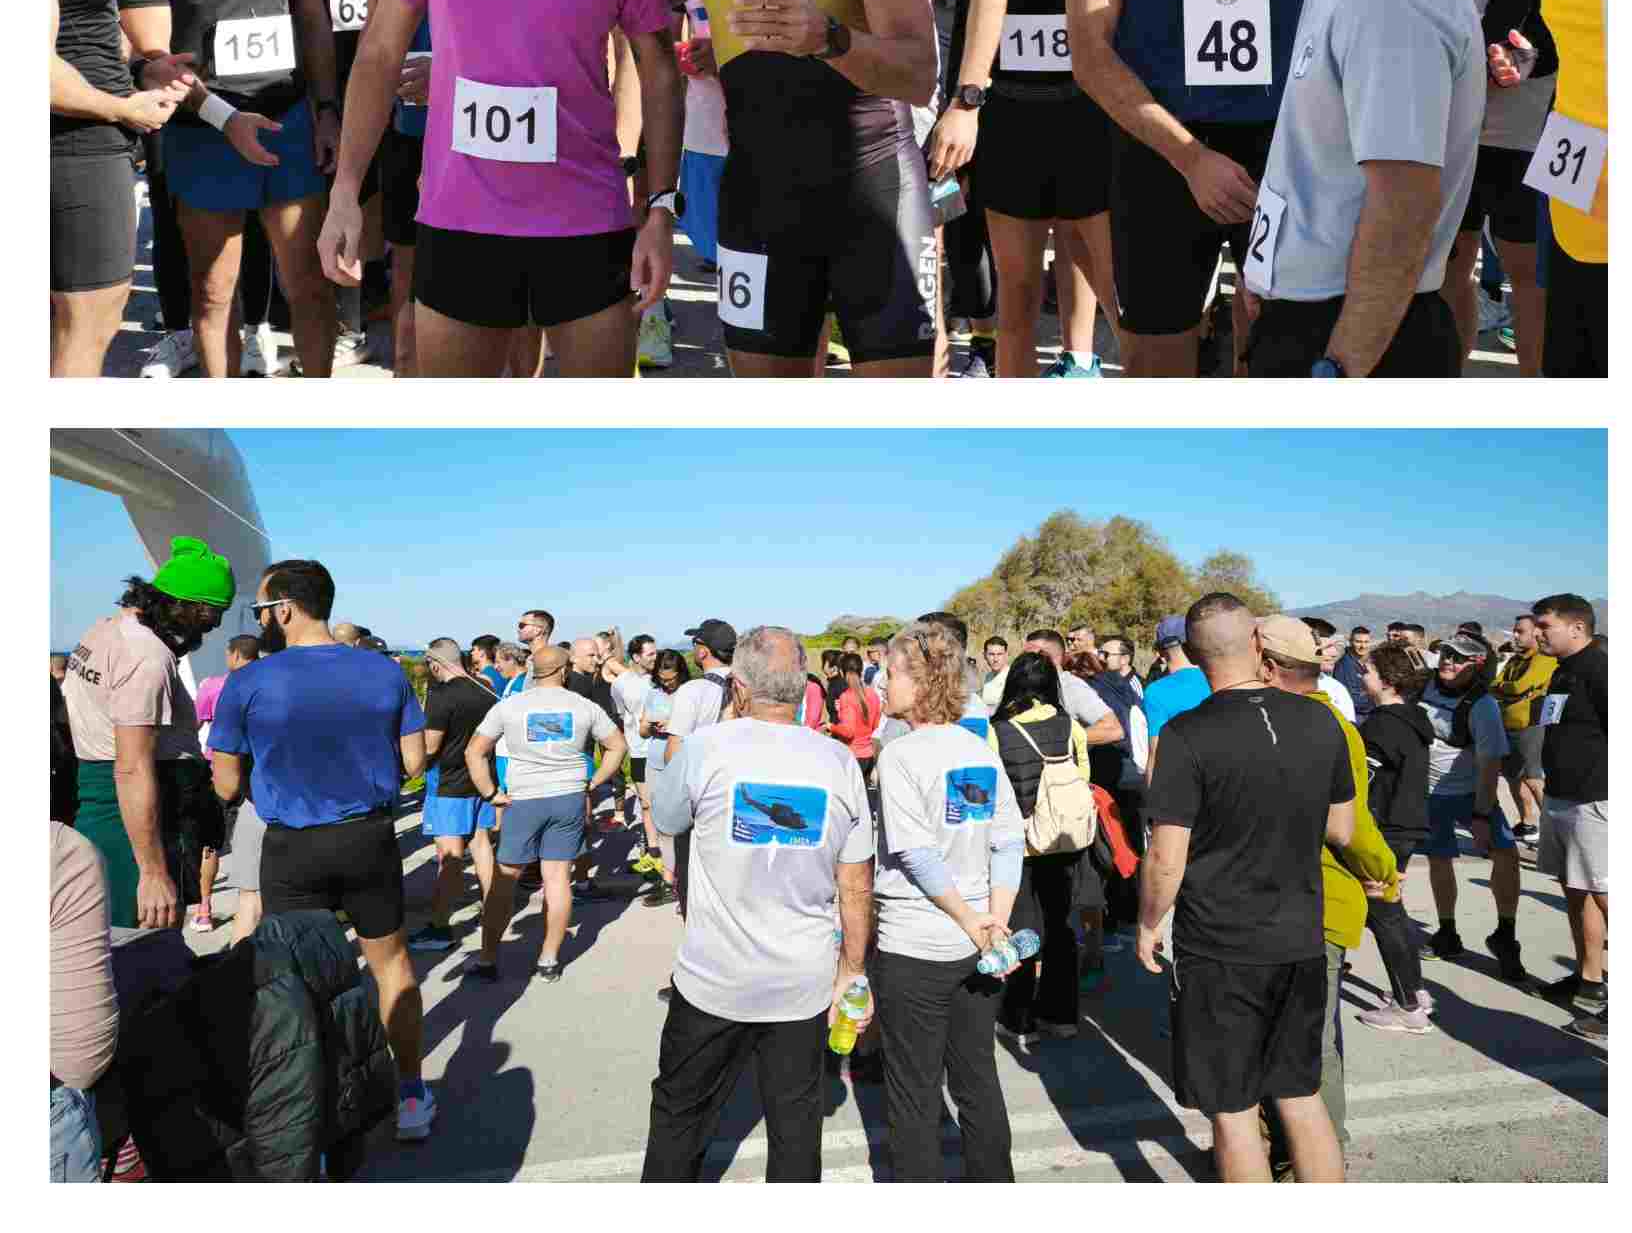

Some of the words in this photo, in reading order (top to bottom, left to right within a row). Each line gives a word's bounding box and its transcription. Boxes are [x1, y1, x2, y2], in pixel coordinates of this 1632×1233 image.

[224, 30, 281, 62] 151
[1009, 28, 1070, 58] 118
[1196, 20, 1259, 72] 48
[462, 100, 538, 145] 101
[1550, 137, 1588, 185] 31
